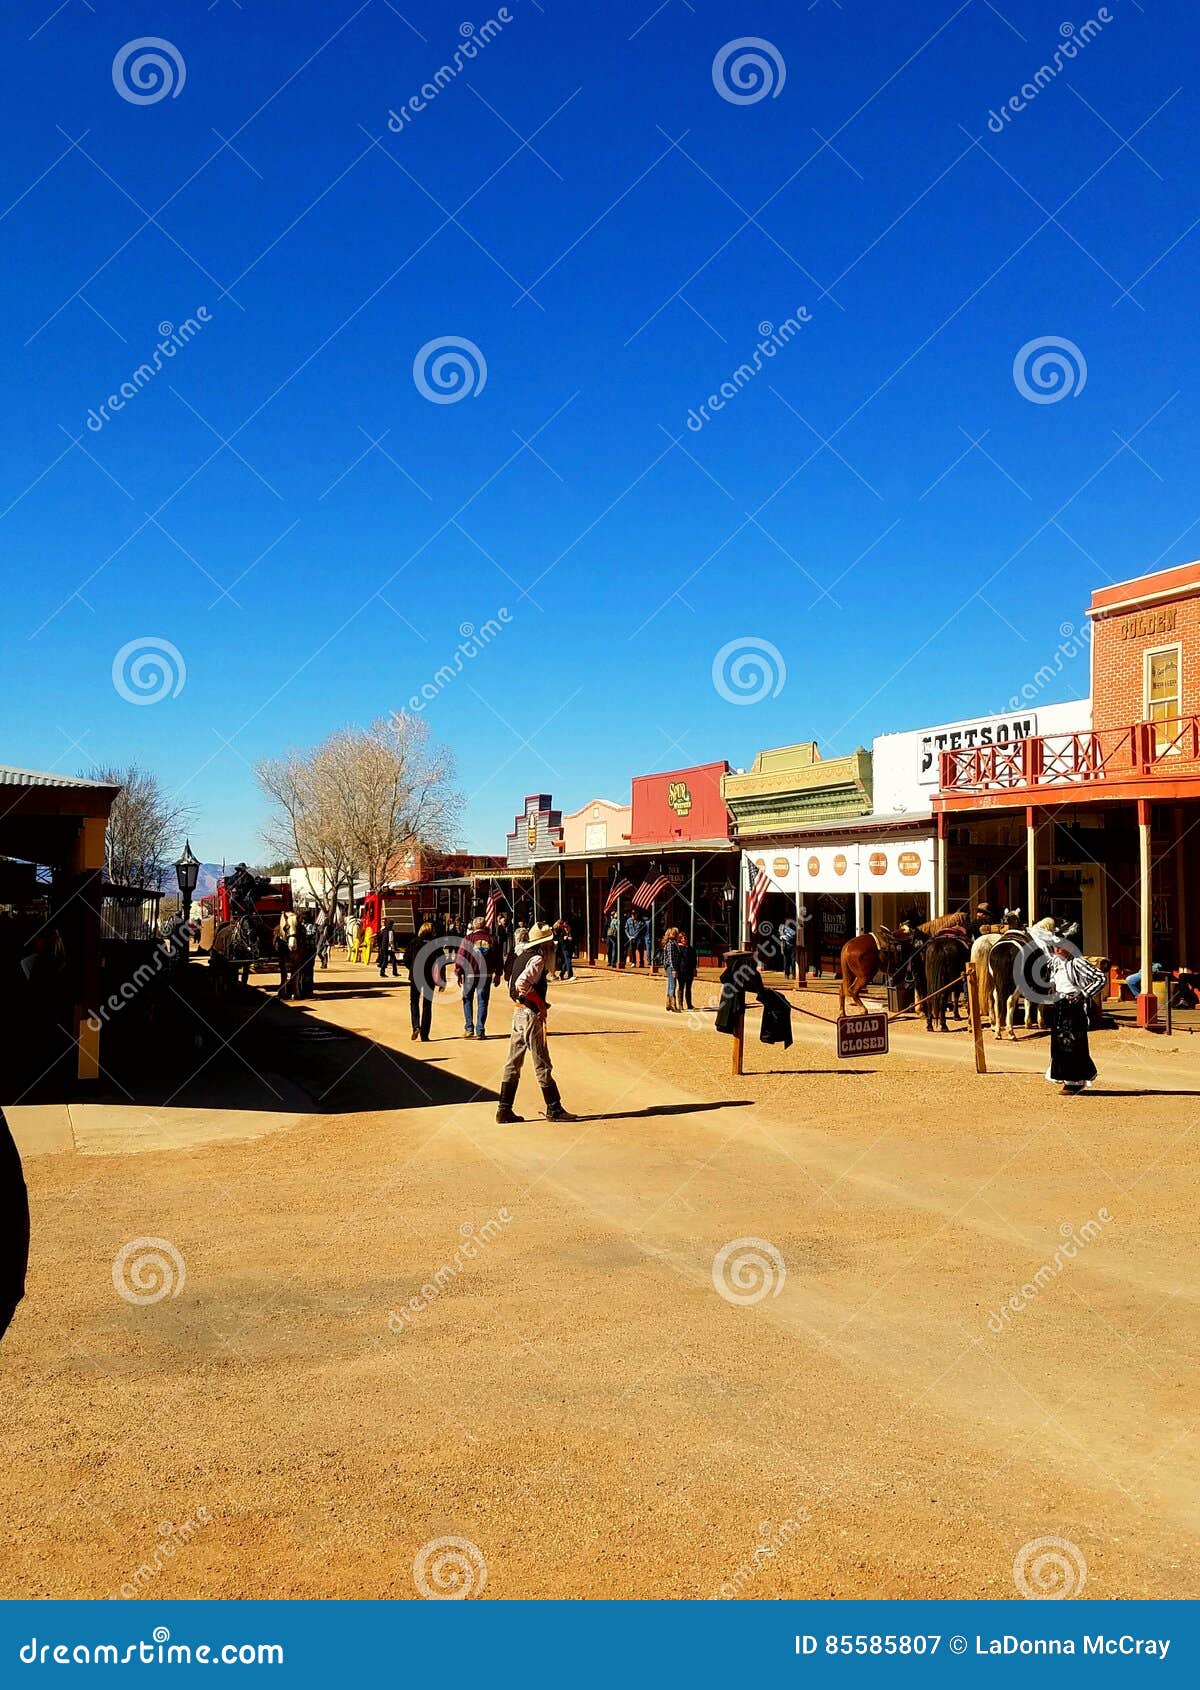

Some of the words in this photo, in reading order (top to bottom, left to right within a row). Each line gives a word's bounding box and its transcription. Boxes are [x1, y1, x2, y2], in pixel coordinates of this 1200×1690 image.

[1120, 608, 1178, 641] GOLDEN
[921, 719, 1031, 773] STETSON
[846, 1020, 880, 1034] ROAD
[841, 1036, 885, 1052] CLOSED
